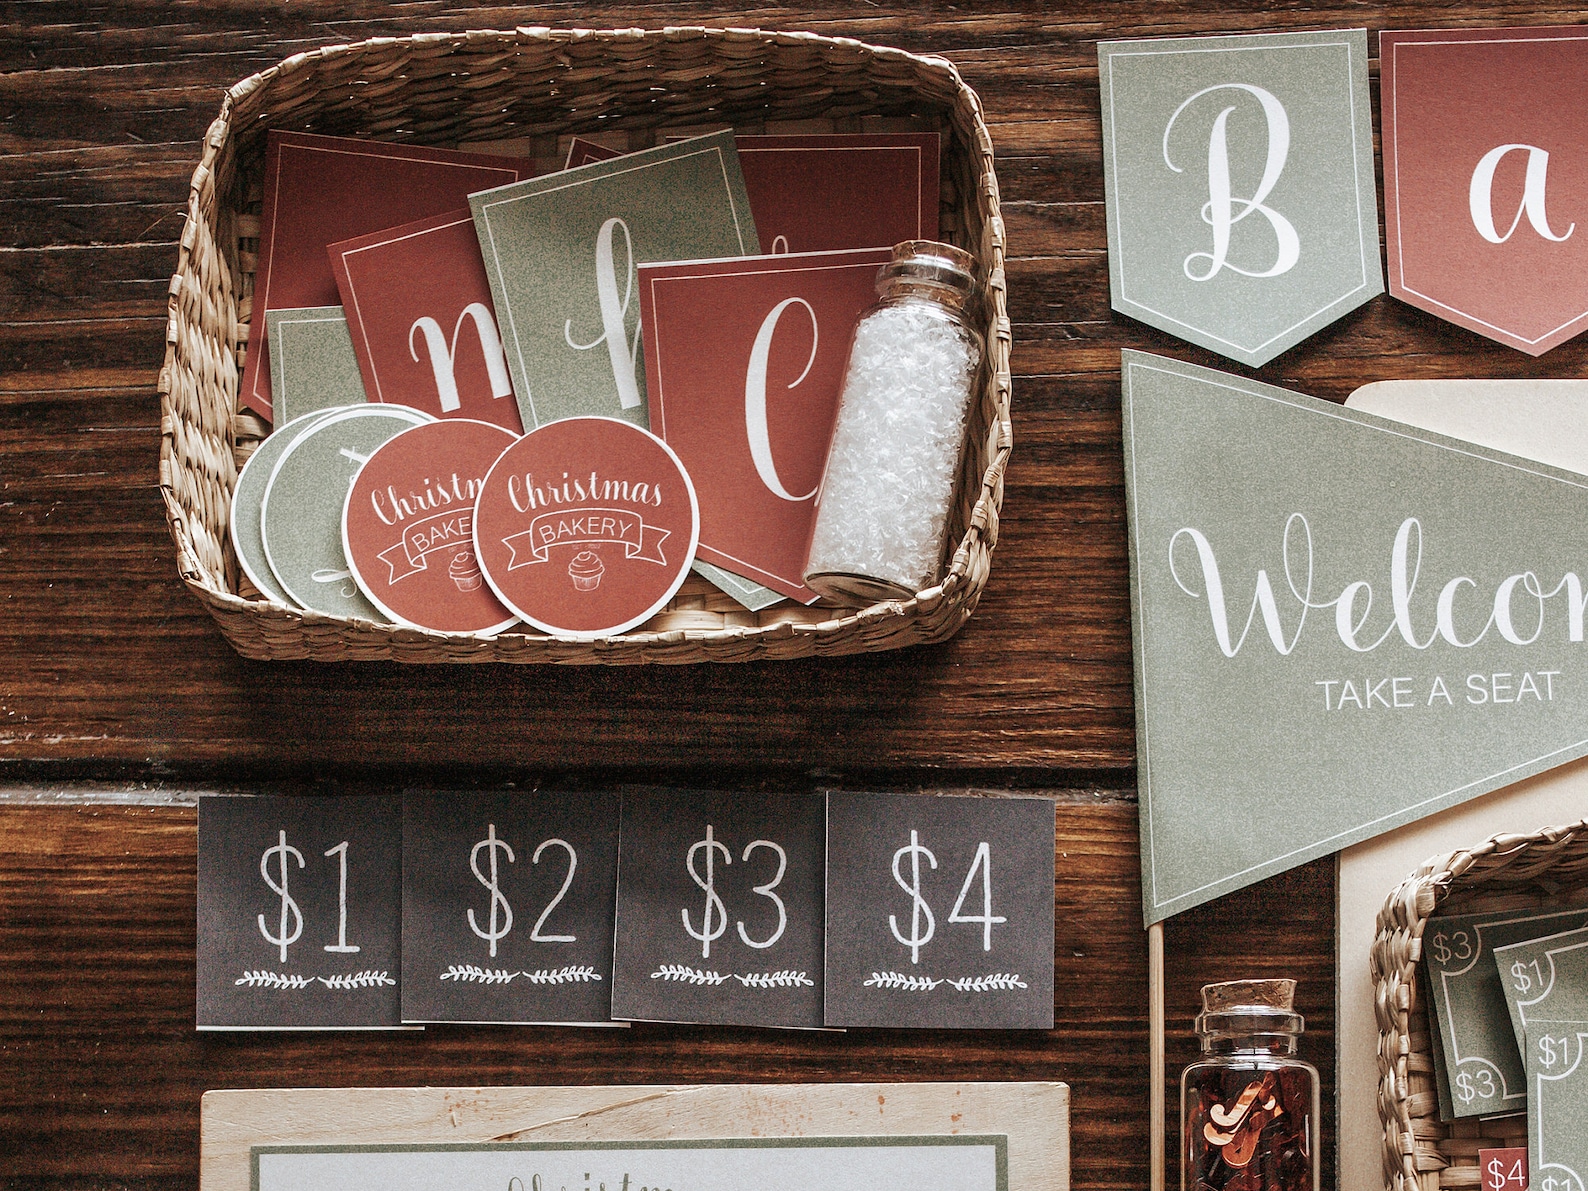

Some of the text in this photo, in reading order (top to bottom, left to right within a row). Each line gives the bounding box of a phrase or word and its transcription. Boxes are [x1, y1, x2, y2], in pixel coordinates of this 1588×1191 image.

[1163, 84, 1300, 281] B
[1470, 144, 1575, 243] a
[508, 471, 661, 513] Christmas
[538, 516, 633, 543] BAKERY
[1315, 671, 1560, 710] TAKE A SEAT
[258, 830, 360, 963] $1
[467, 824, 577, 957] $2
[682, 825, 787, 958] $3
[889, 830, 1007, 964] $4
[1433, 932, 1473, 967] $3
[1511, 960, 1543, 995] $1
[1539, 1034, 1567, 1069] $1
[1456, 1070, 1494, 1105] $3
